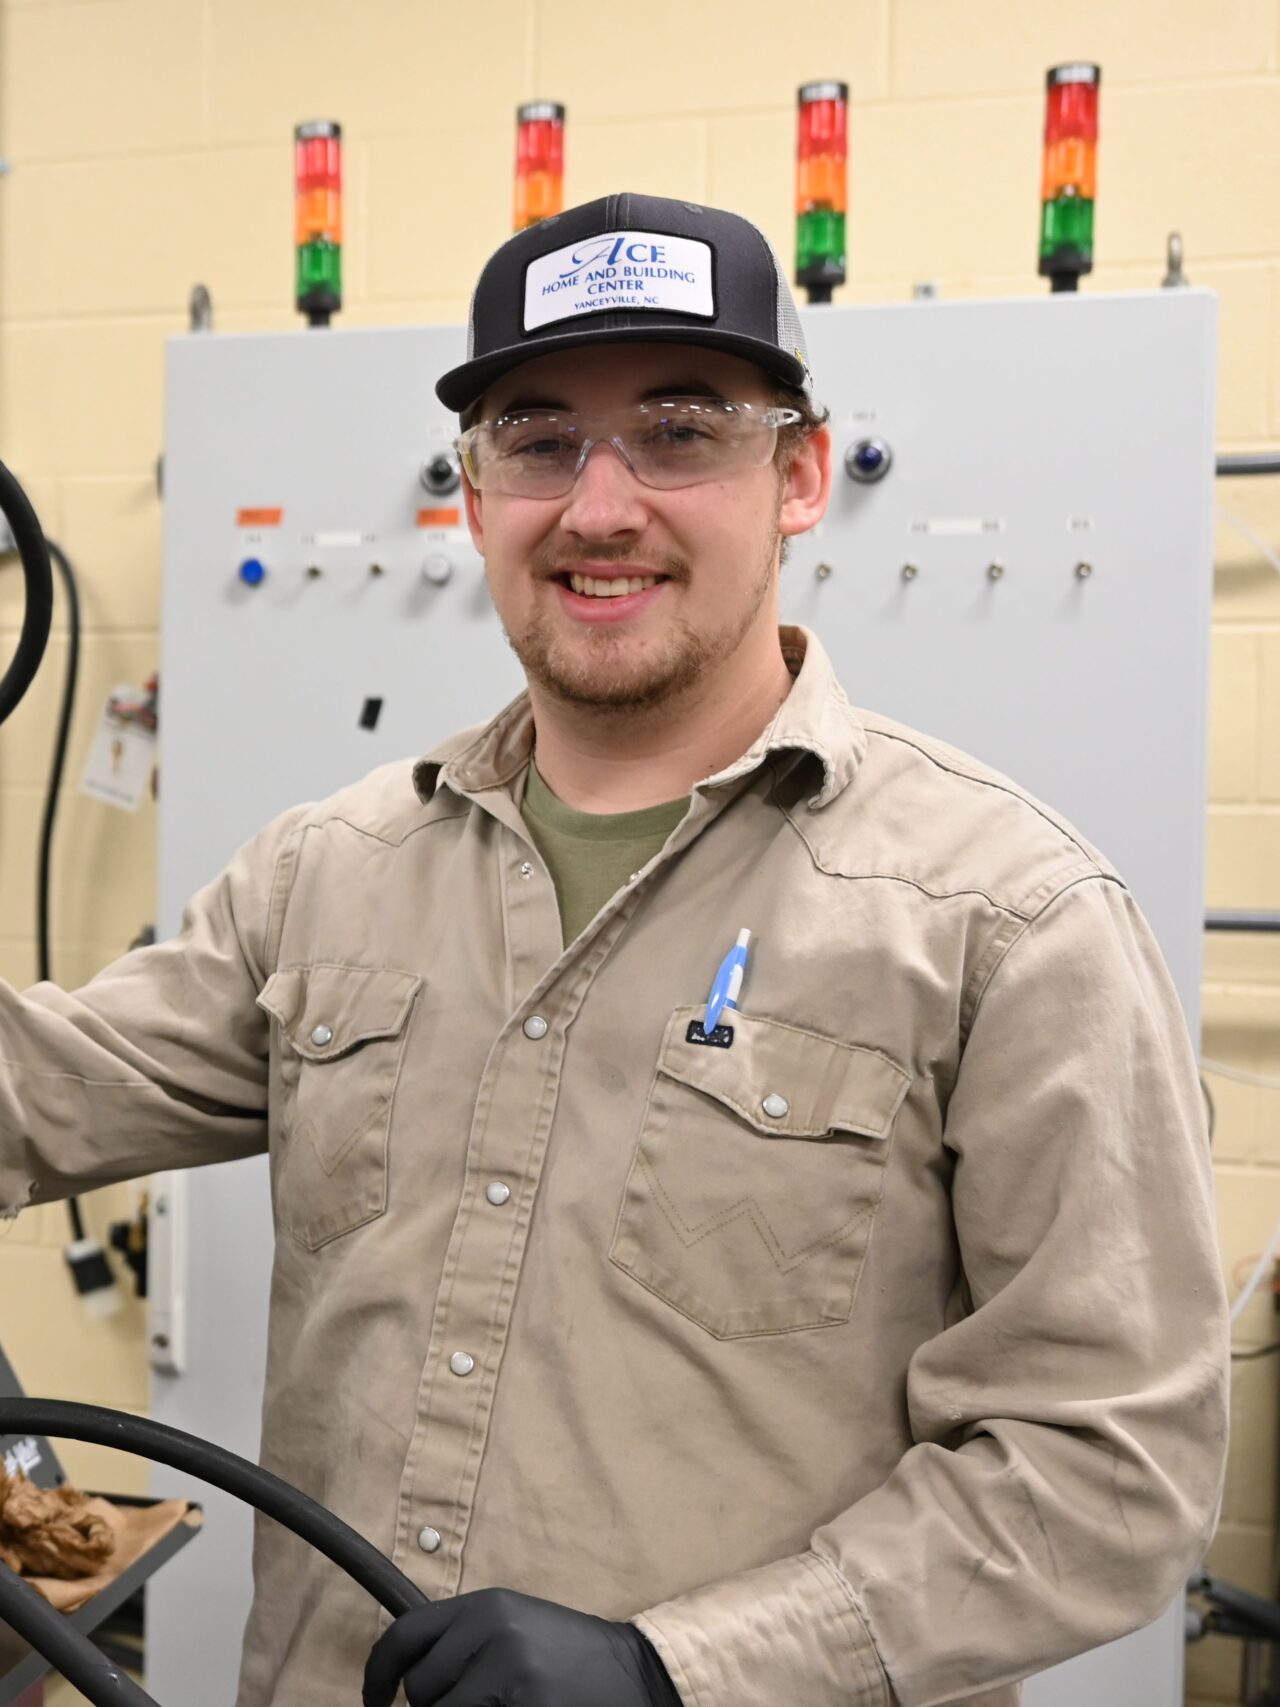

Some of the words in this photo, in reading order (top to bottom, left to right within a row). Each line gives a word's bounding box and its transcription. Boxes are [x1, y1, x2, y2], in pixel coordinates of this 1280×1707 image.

[541, 275, 579, 296] HOME
[585, 267, 617, 283] AND
[623, 266, 696, 284] BUILDING
[587, 279, 645, 295] CENTER
[574, 296, 640, 311] YANCEYVILLE,
[643, 296, 660, 305] NC
